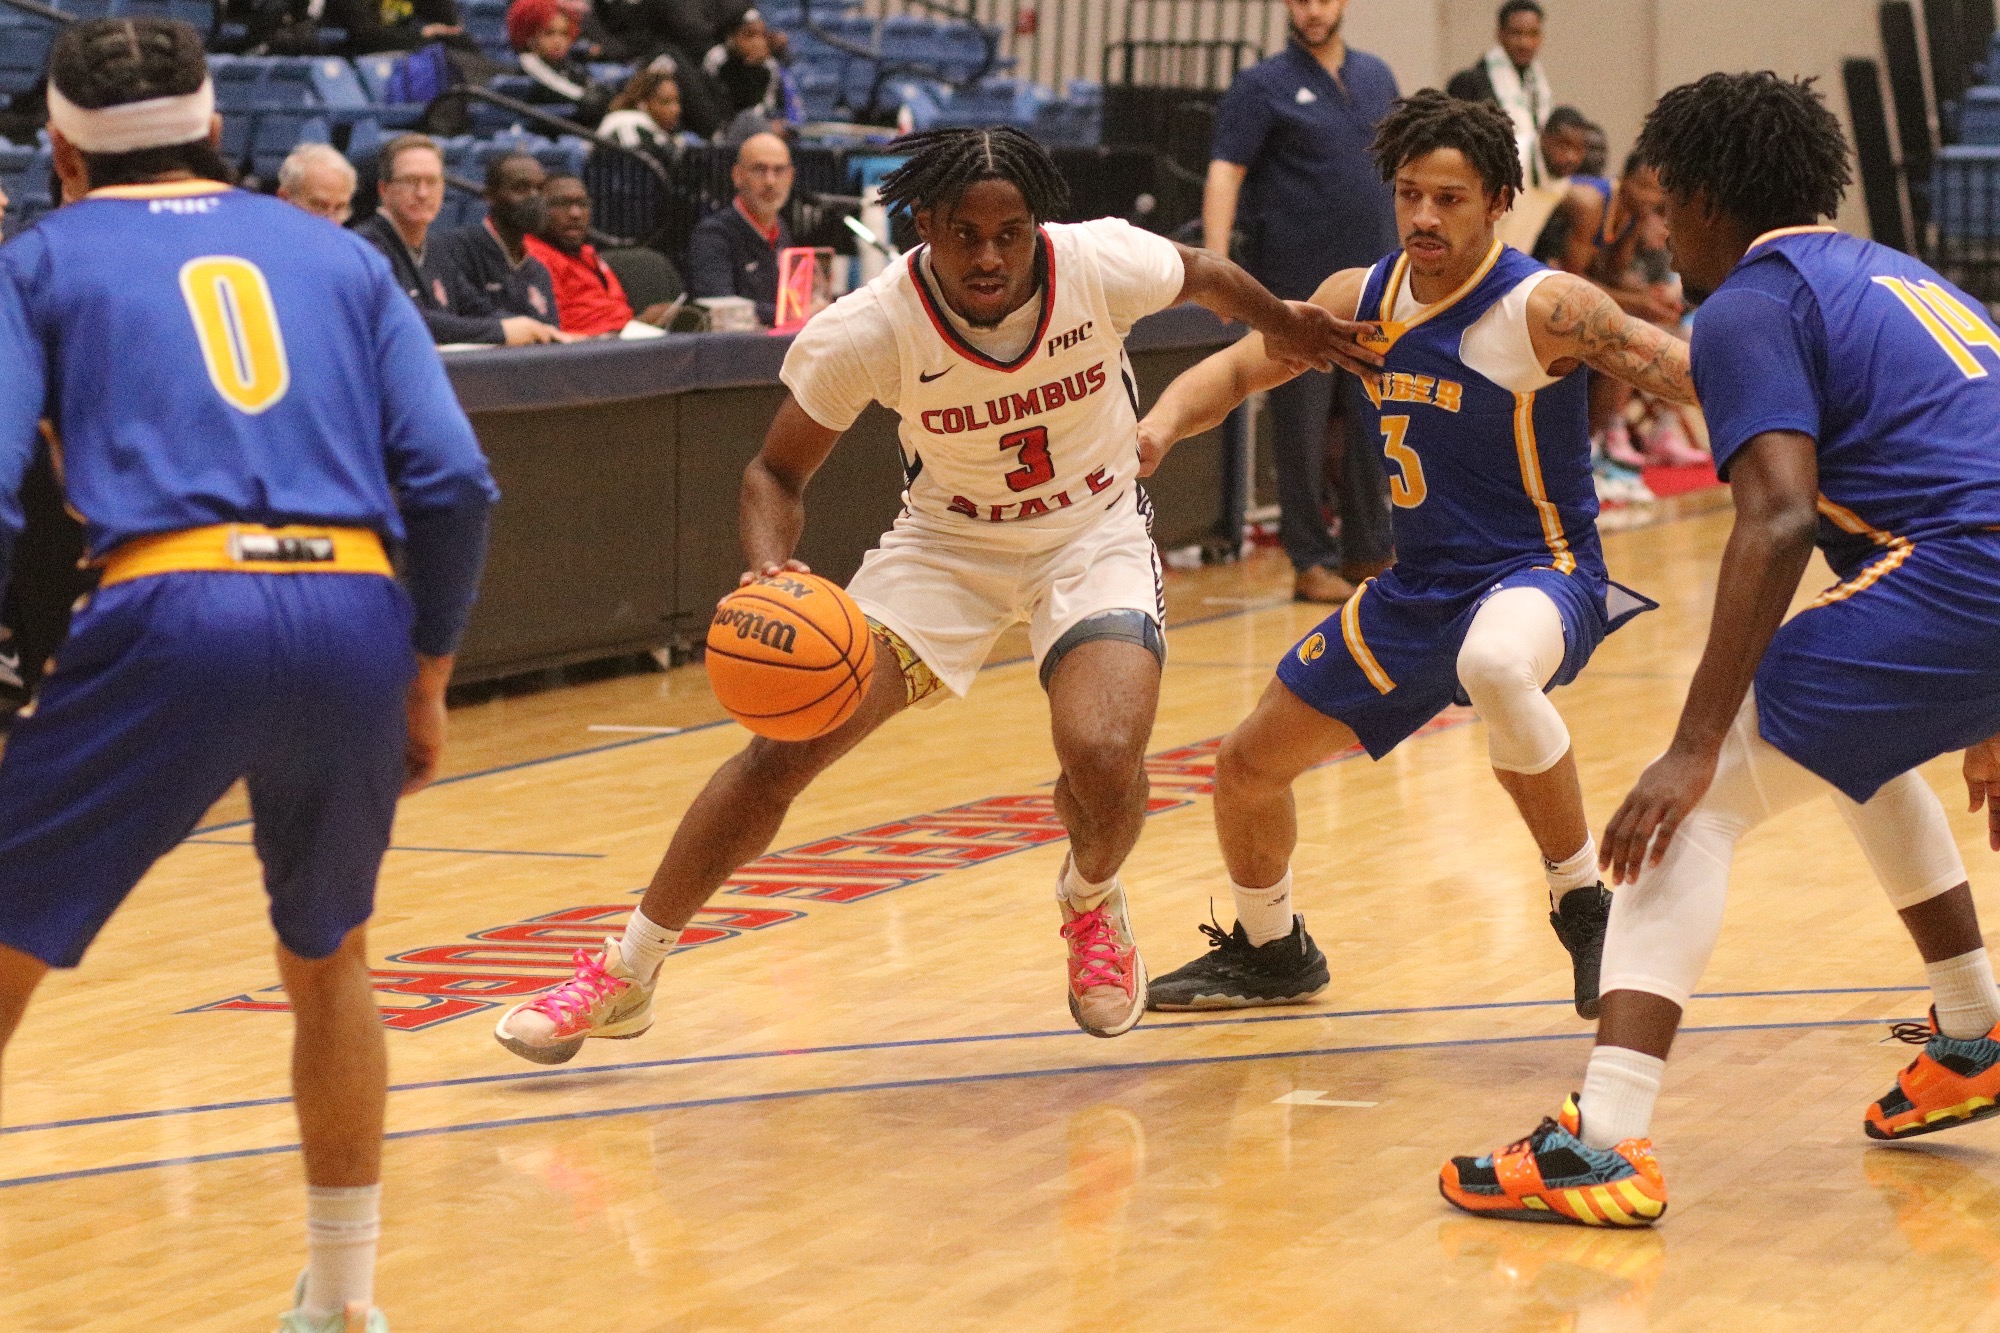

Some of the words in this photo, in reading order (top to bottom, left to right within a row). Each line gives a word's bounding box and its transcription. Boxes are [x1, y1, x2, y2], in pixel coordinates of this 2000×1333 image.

[178, 255, 291, 416] 0
[1048, 320, 1093, 358] PBC
[1870, 275, 2000, 379] 14
[921, 361, 1106, 434] COLUMBUS
[998, 425, 1056, 492] 3
[1380, 414, 1428, 509] 3
